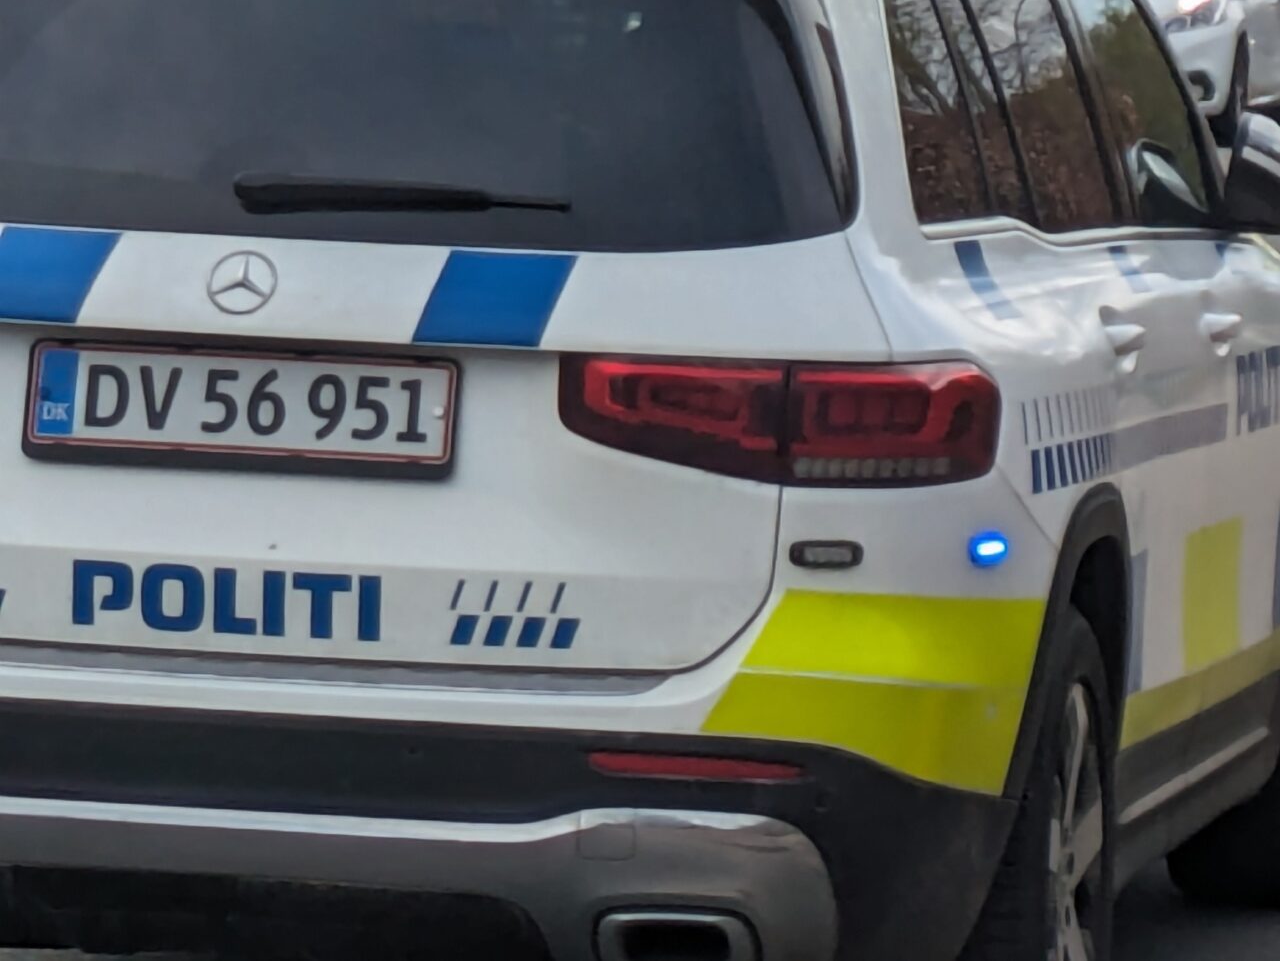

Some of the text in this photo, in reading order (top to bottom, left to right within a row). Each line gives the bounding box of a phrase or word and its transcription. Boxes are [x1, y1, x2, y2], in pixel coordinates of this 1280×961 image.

[42, 401, 69, 421] DK
[84, 364, 427, 443] DV 56 951
[72, 559, 382, 642] POLITI
